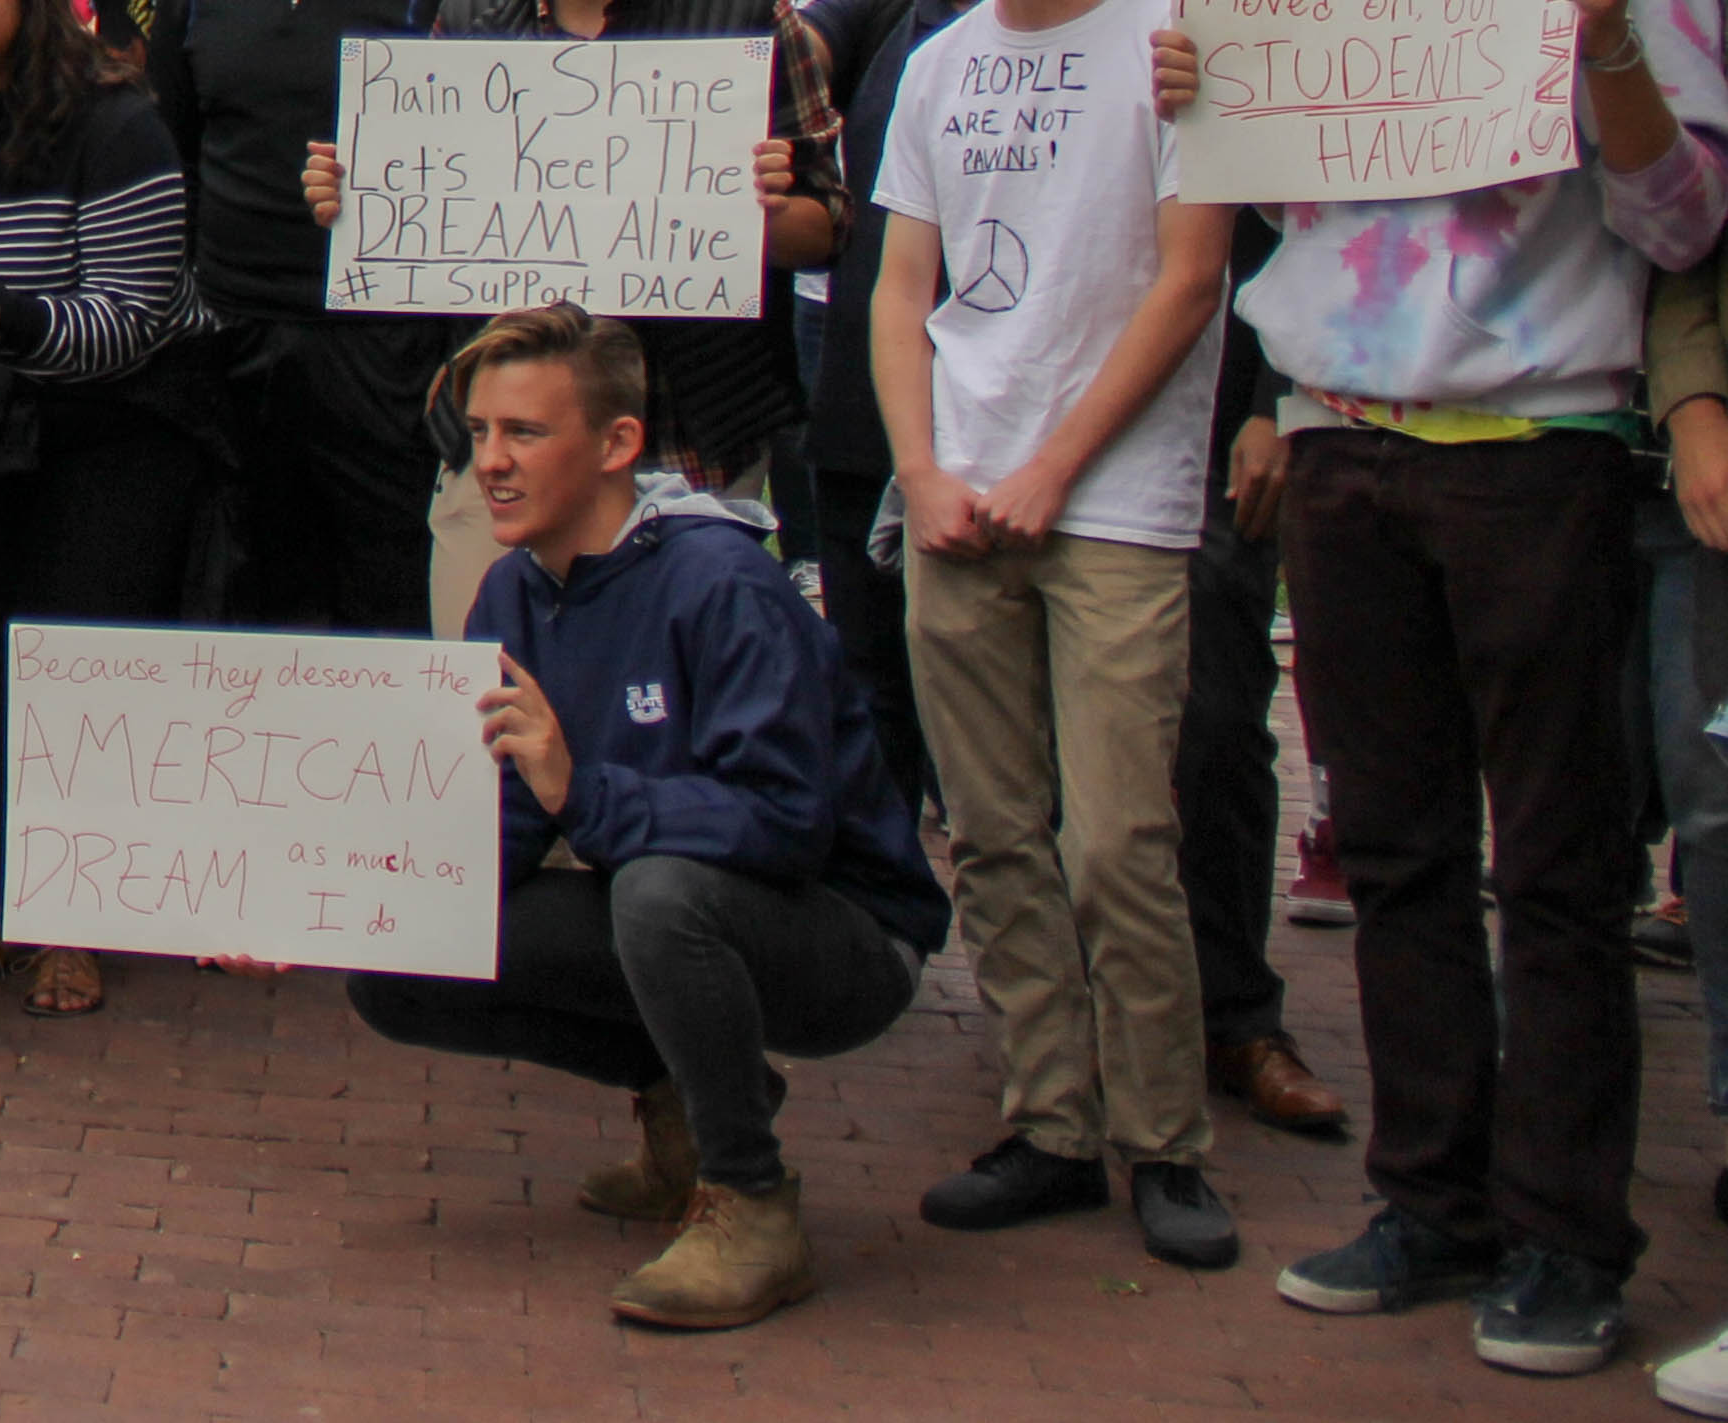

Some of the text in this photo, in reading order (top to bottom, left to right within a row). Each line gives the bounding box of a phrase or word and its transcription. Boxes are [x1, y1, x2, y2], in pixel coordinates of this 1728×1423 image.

[361, 39, 733, 116] Rain Or Shine
[959, 53, 1088, 97] PEOPLE
[1204, 24, 1505, 108] STUDENTS
[1529, 8, 1579, 162] SAVE
[350, 113, 468, 192] Let's
[648, 119, 743, 196] The
[941, 107, 1085, 138] ARE NOT
[358, 193, 739, 263] DREAM Alive
[621, 273, 731, 311] DACA
[15, 627, 472, 719] Because they deserve the
[17, 703, 465, 808] AMERICAN
[13, 826, 466, 920] DREAM as much as
[306, 891, 396, 936] I do
